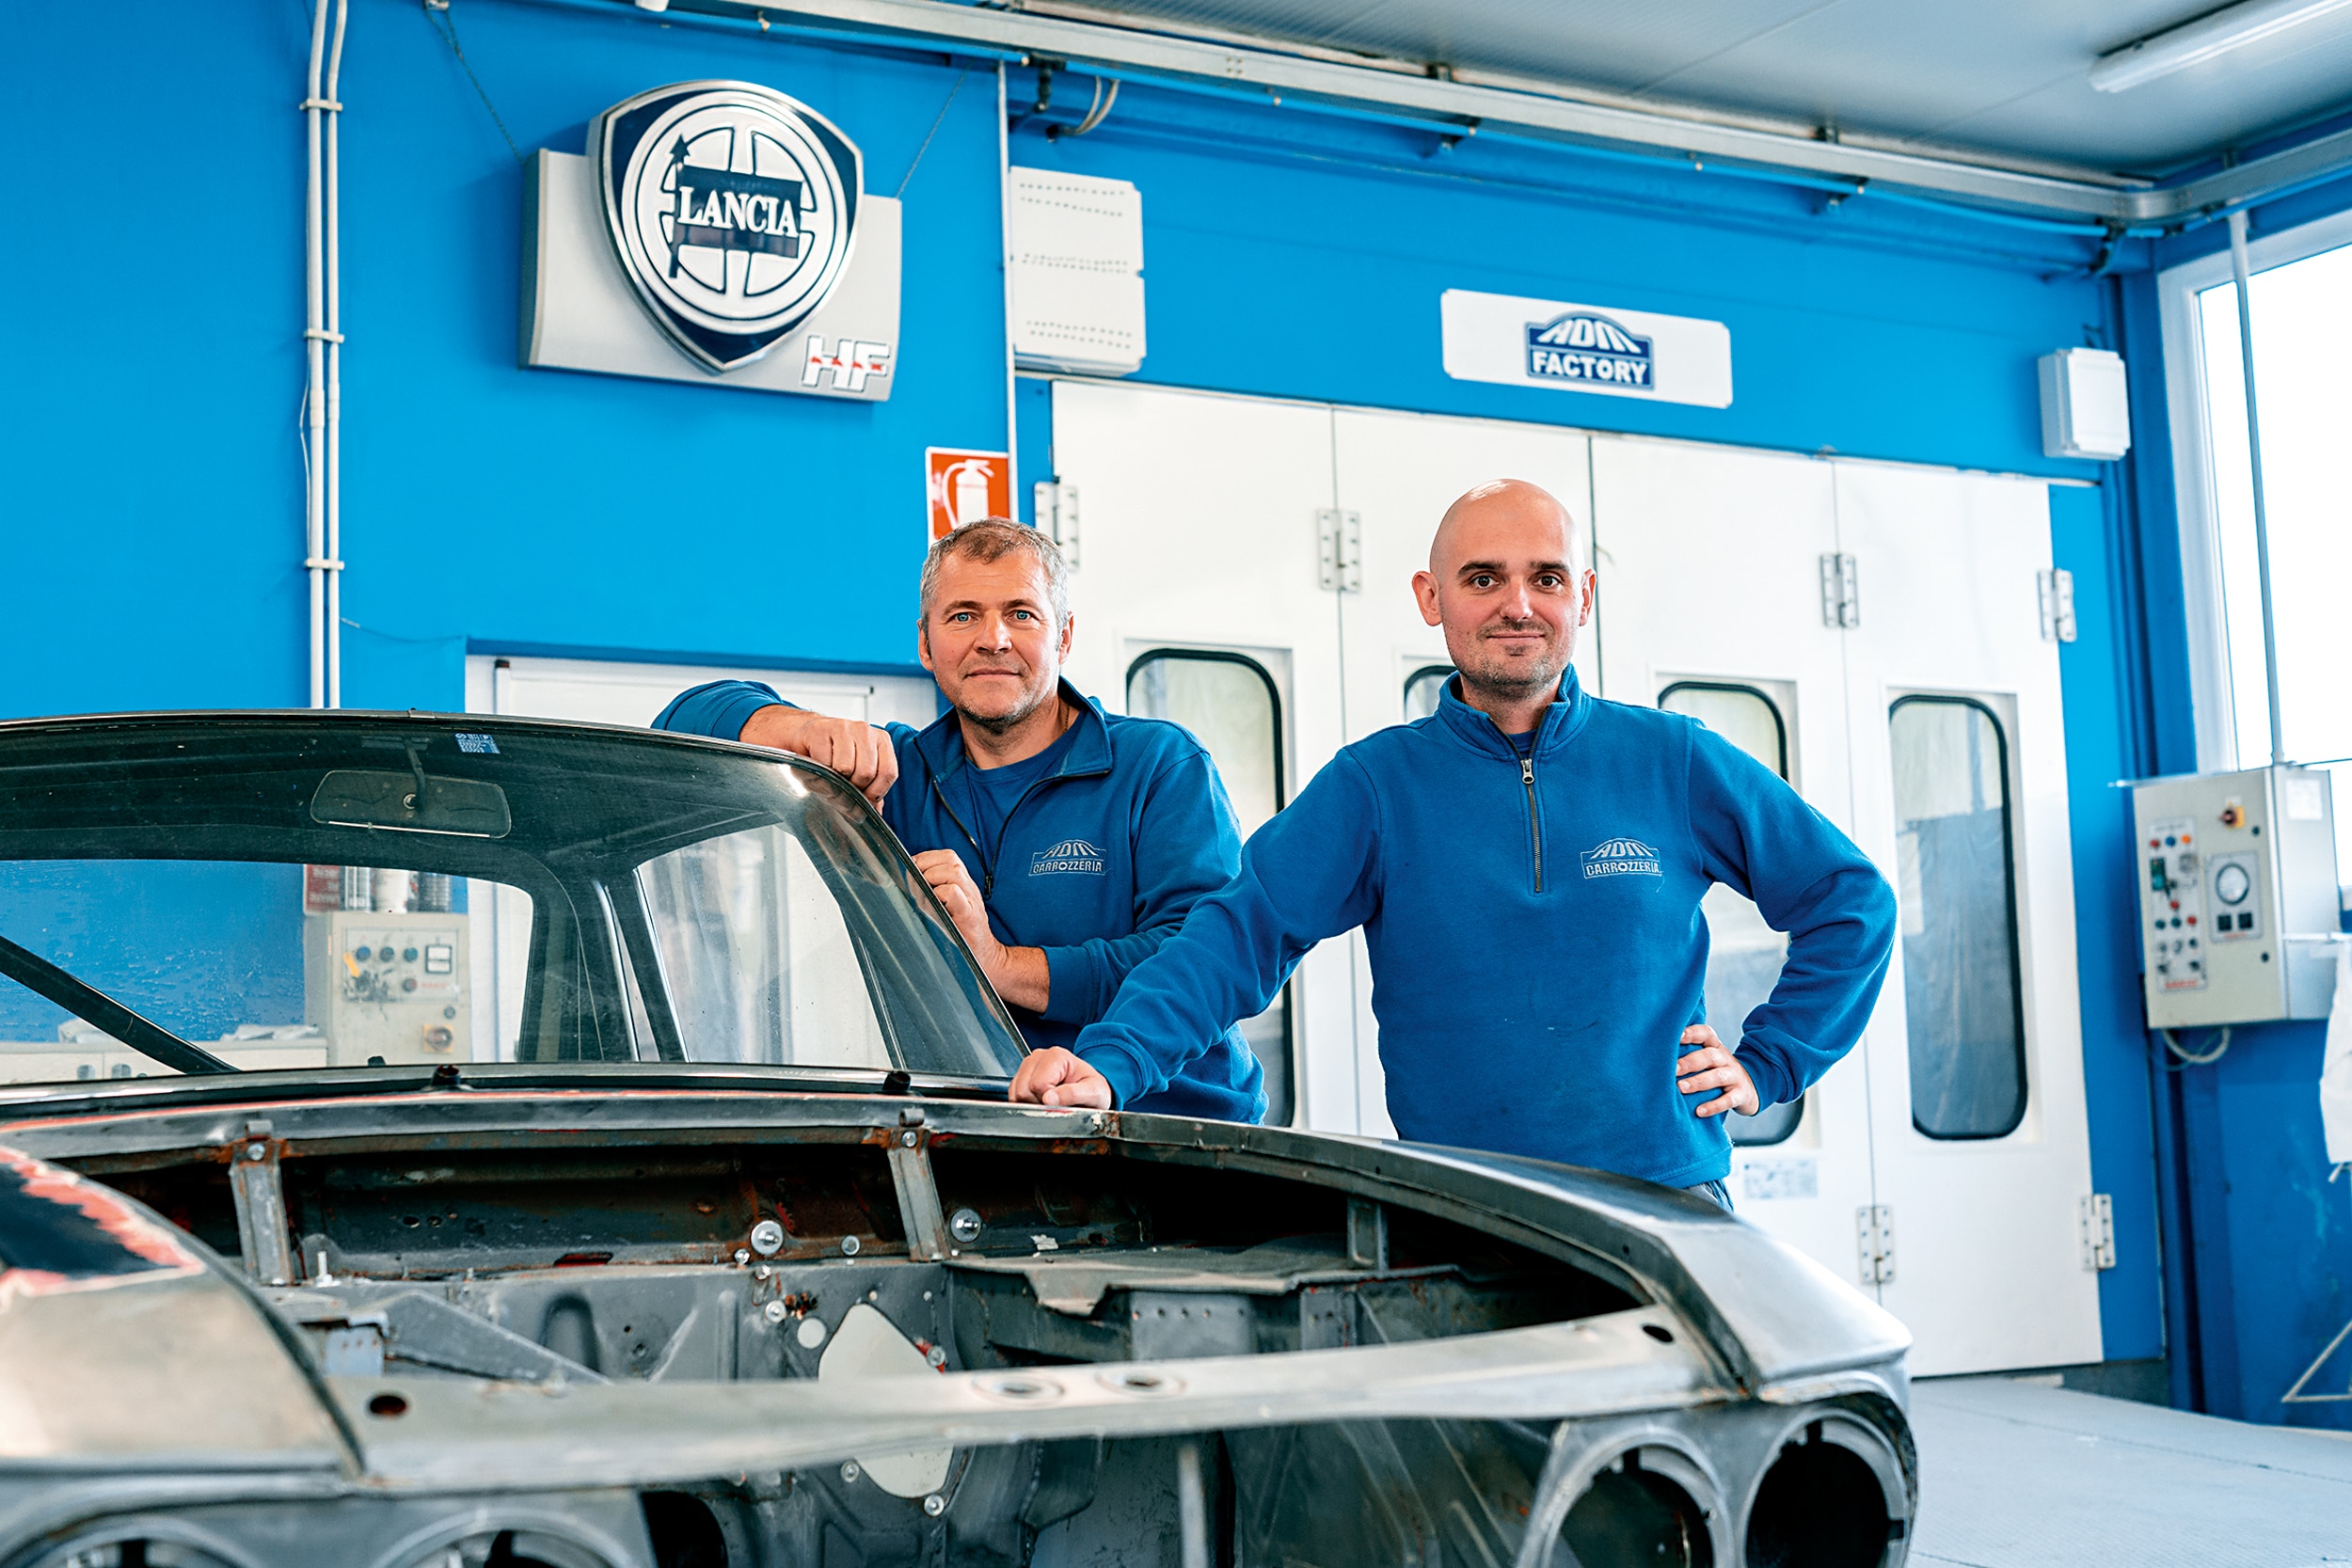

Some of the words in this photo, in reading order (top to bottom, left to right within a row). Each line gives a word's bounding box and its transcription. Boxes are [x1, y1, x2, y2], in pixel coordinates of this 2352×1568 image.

[677, 185, 800, 237] LANCIA
[1536, 318, 1642, 354] ADM
[802, 335, 890, 392] HF
[1533, 351, 1647, 385] FACTORY
[1041, 842, 1099, 859] ADM
[1590, 842, 1654, 859] ADM
[1585, 862, 1660, 876] CARROZZERIA
